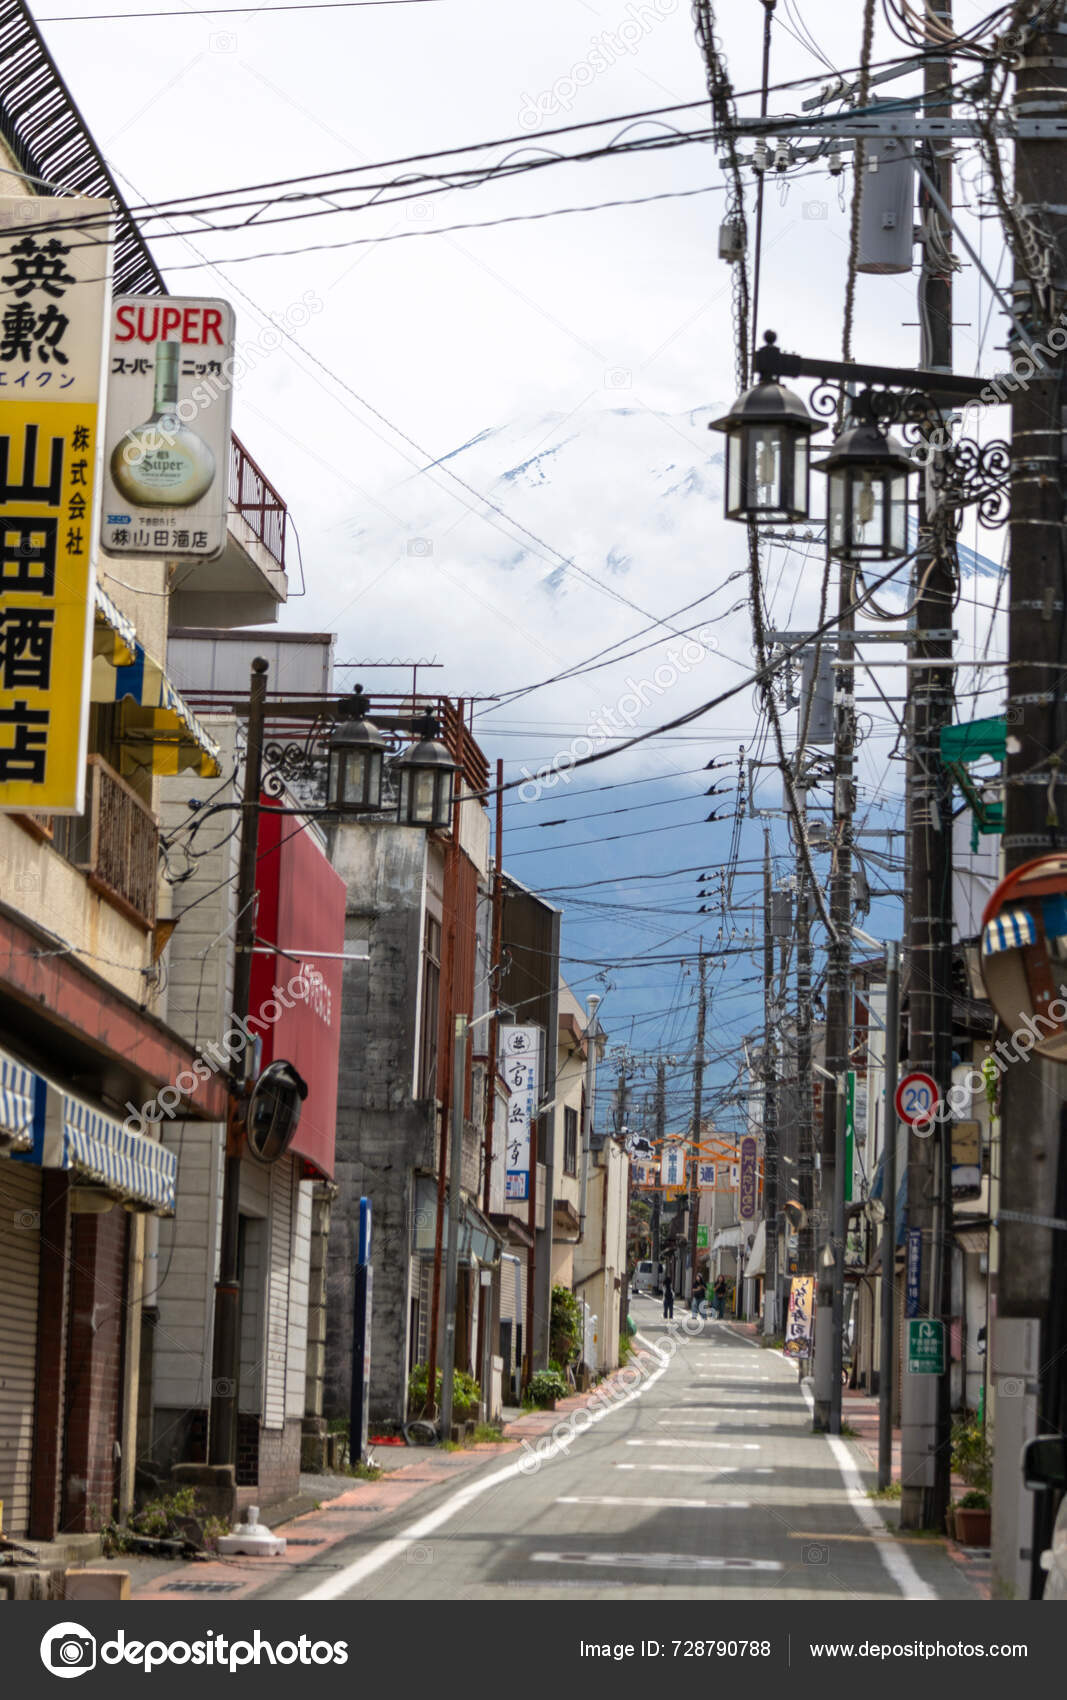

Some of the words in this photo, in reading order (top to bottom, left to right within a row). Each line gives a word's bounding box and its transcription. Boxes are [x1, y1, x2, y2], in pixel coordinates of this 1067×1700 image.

[1, 236, 76, 365] 英勲
[115, 305, 224, 345] SUPER
[112, 358, 154, 375] スーパー
[182, 360, 222, 376] ニッカ
[66, 425, 90, 555] 株式会社
[0, 424, 64, 784] 山田酒店
[905, 1088, 930, 1111] 20
